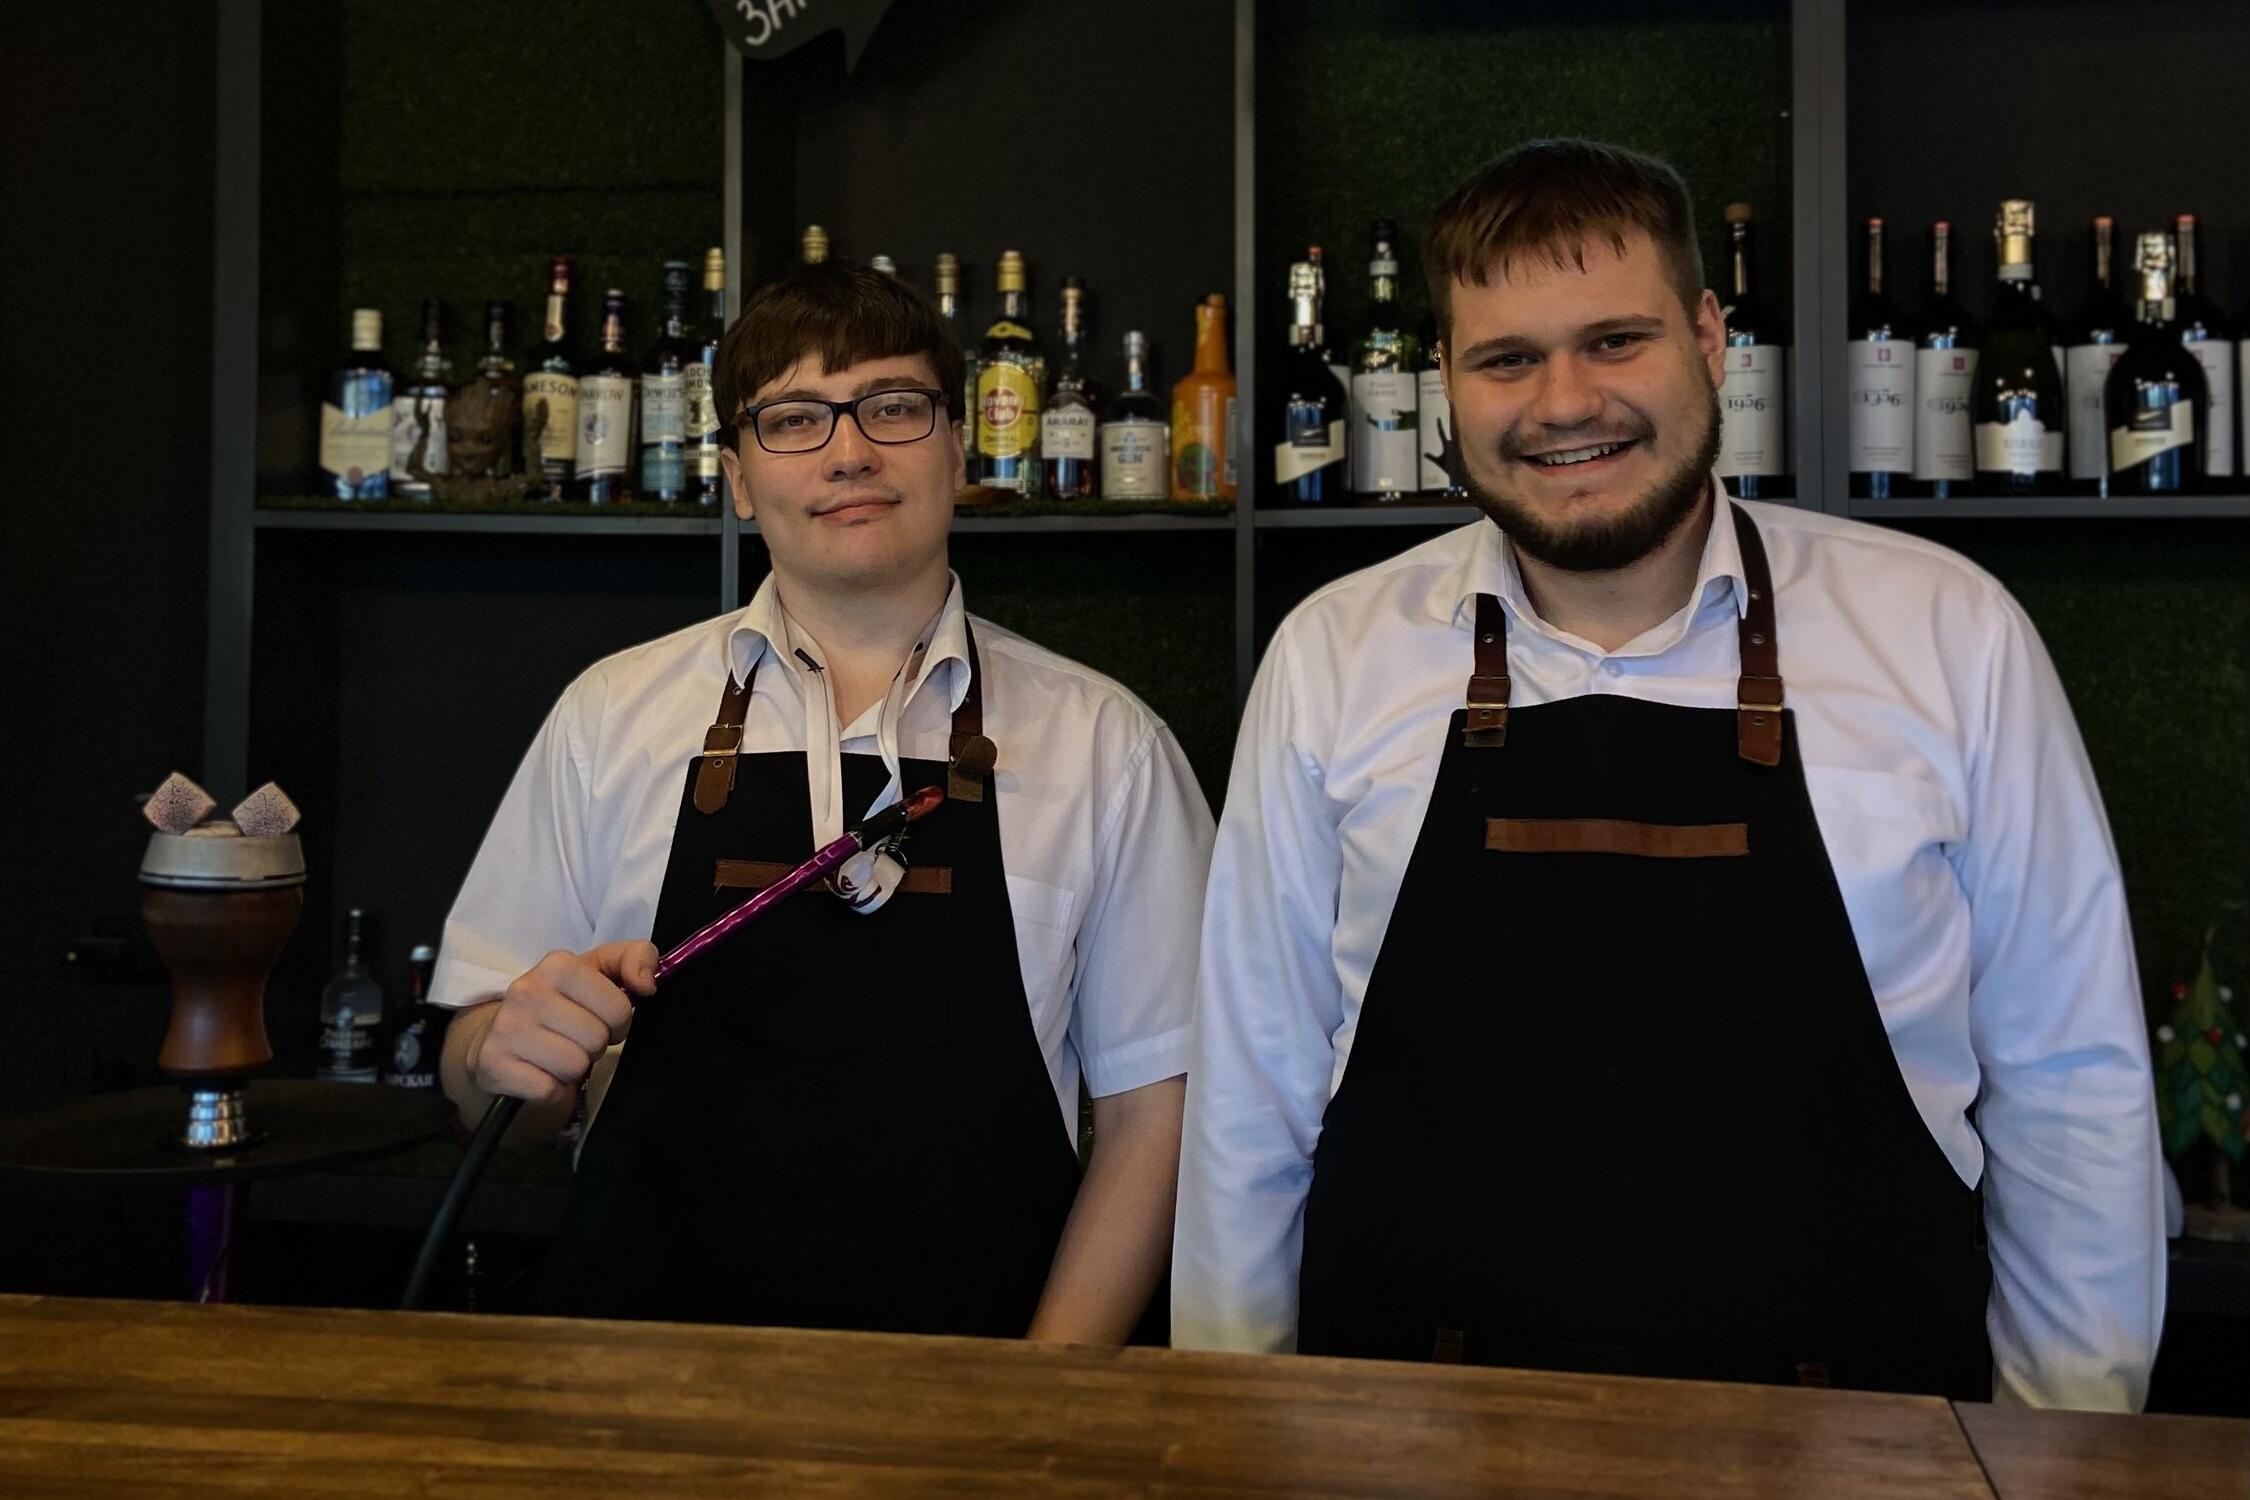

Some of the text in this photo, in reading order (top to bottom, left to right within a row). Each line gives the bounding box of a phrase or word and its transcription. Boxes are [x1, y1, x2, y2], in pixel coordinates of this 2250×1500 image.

[524, 379, 578, 399] AMESON
[1727, 393, 1765, 412] 1956
[1936, 397, 1970, 414] 195
[987, 407, 1015, 420] Club
[1047, 416, 1089, 426] ARARAT
